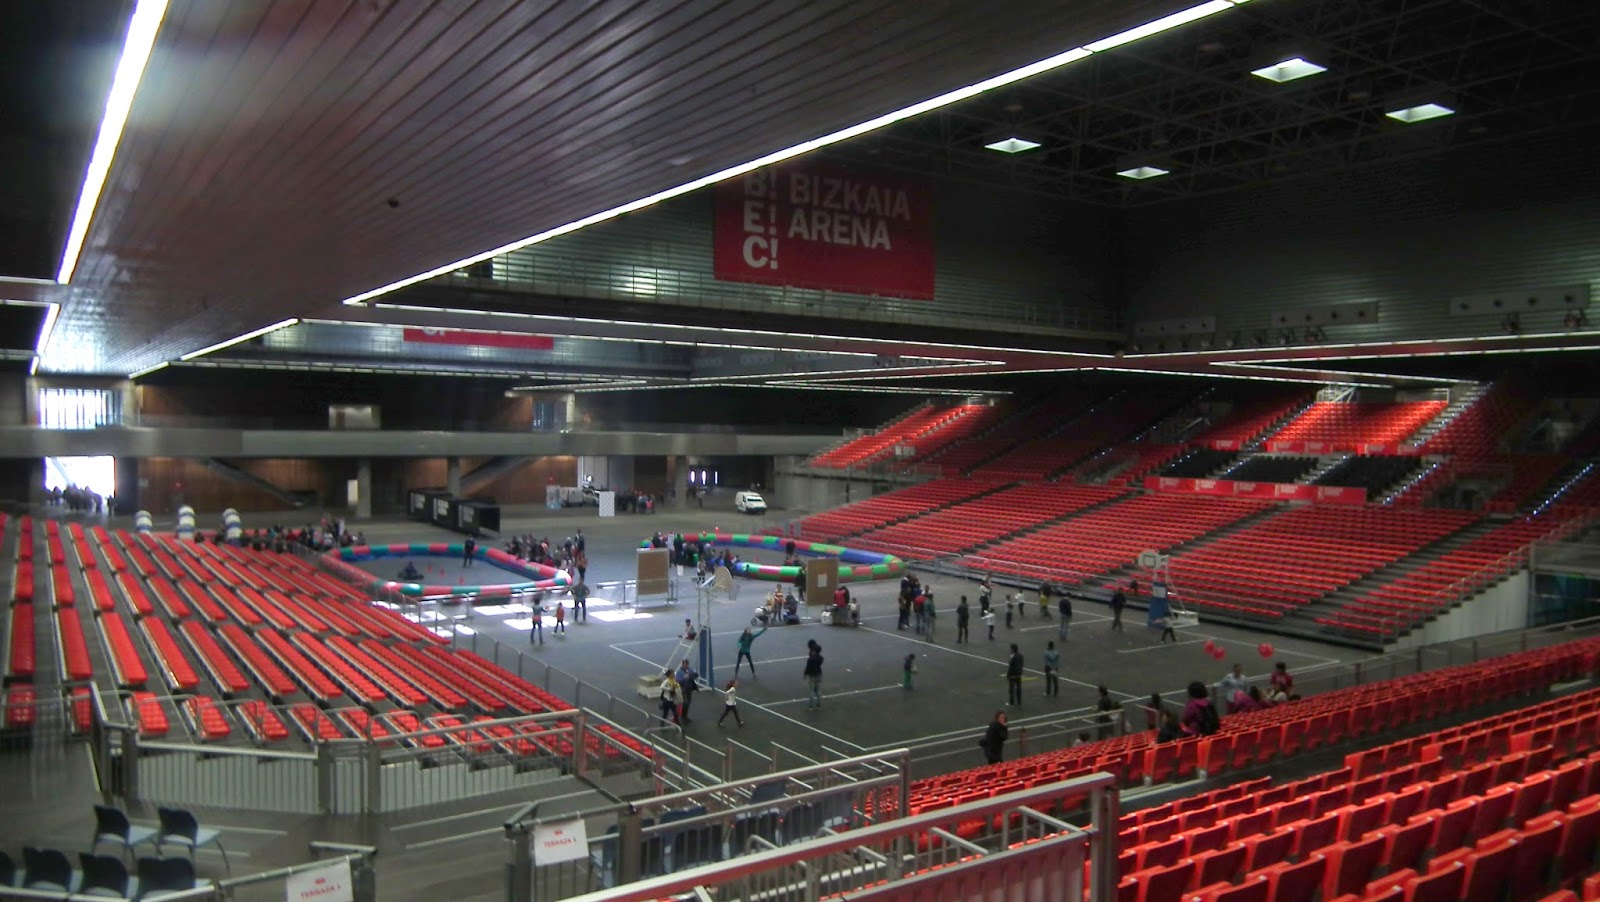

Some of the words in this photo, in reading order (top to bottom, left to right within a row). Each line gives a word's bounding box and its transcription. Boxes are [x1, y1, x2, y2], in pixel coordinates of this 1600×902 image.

[789, 172, 912, 221] BIZKAIA
[743, 201, 777, 235] E!
[788, 208, 892, 250] ARENA
[742, 235, 779, 270] C!
